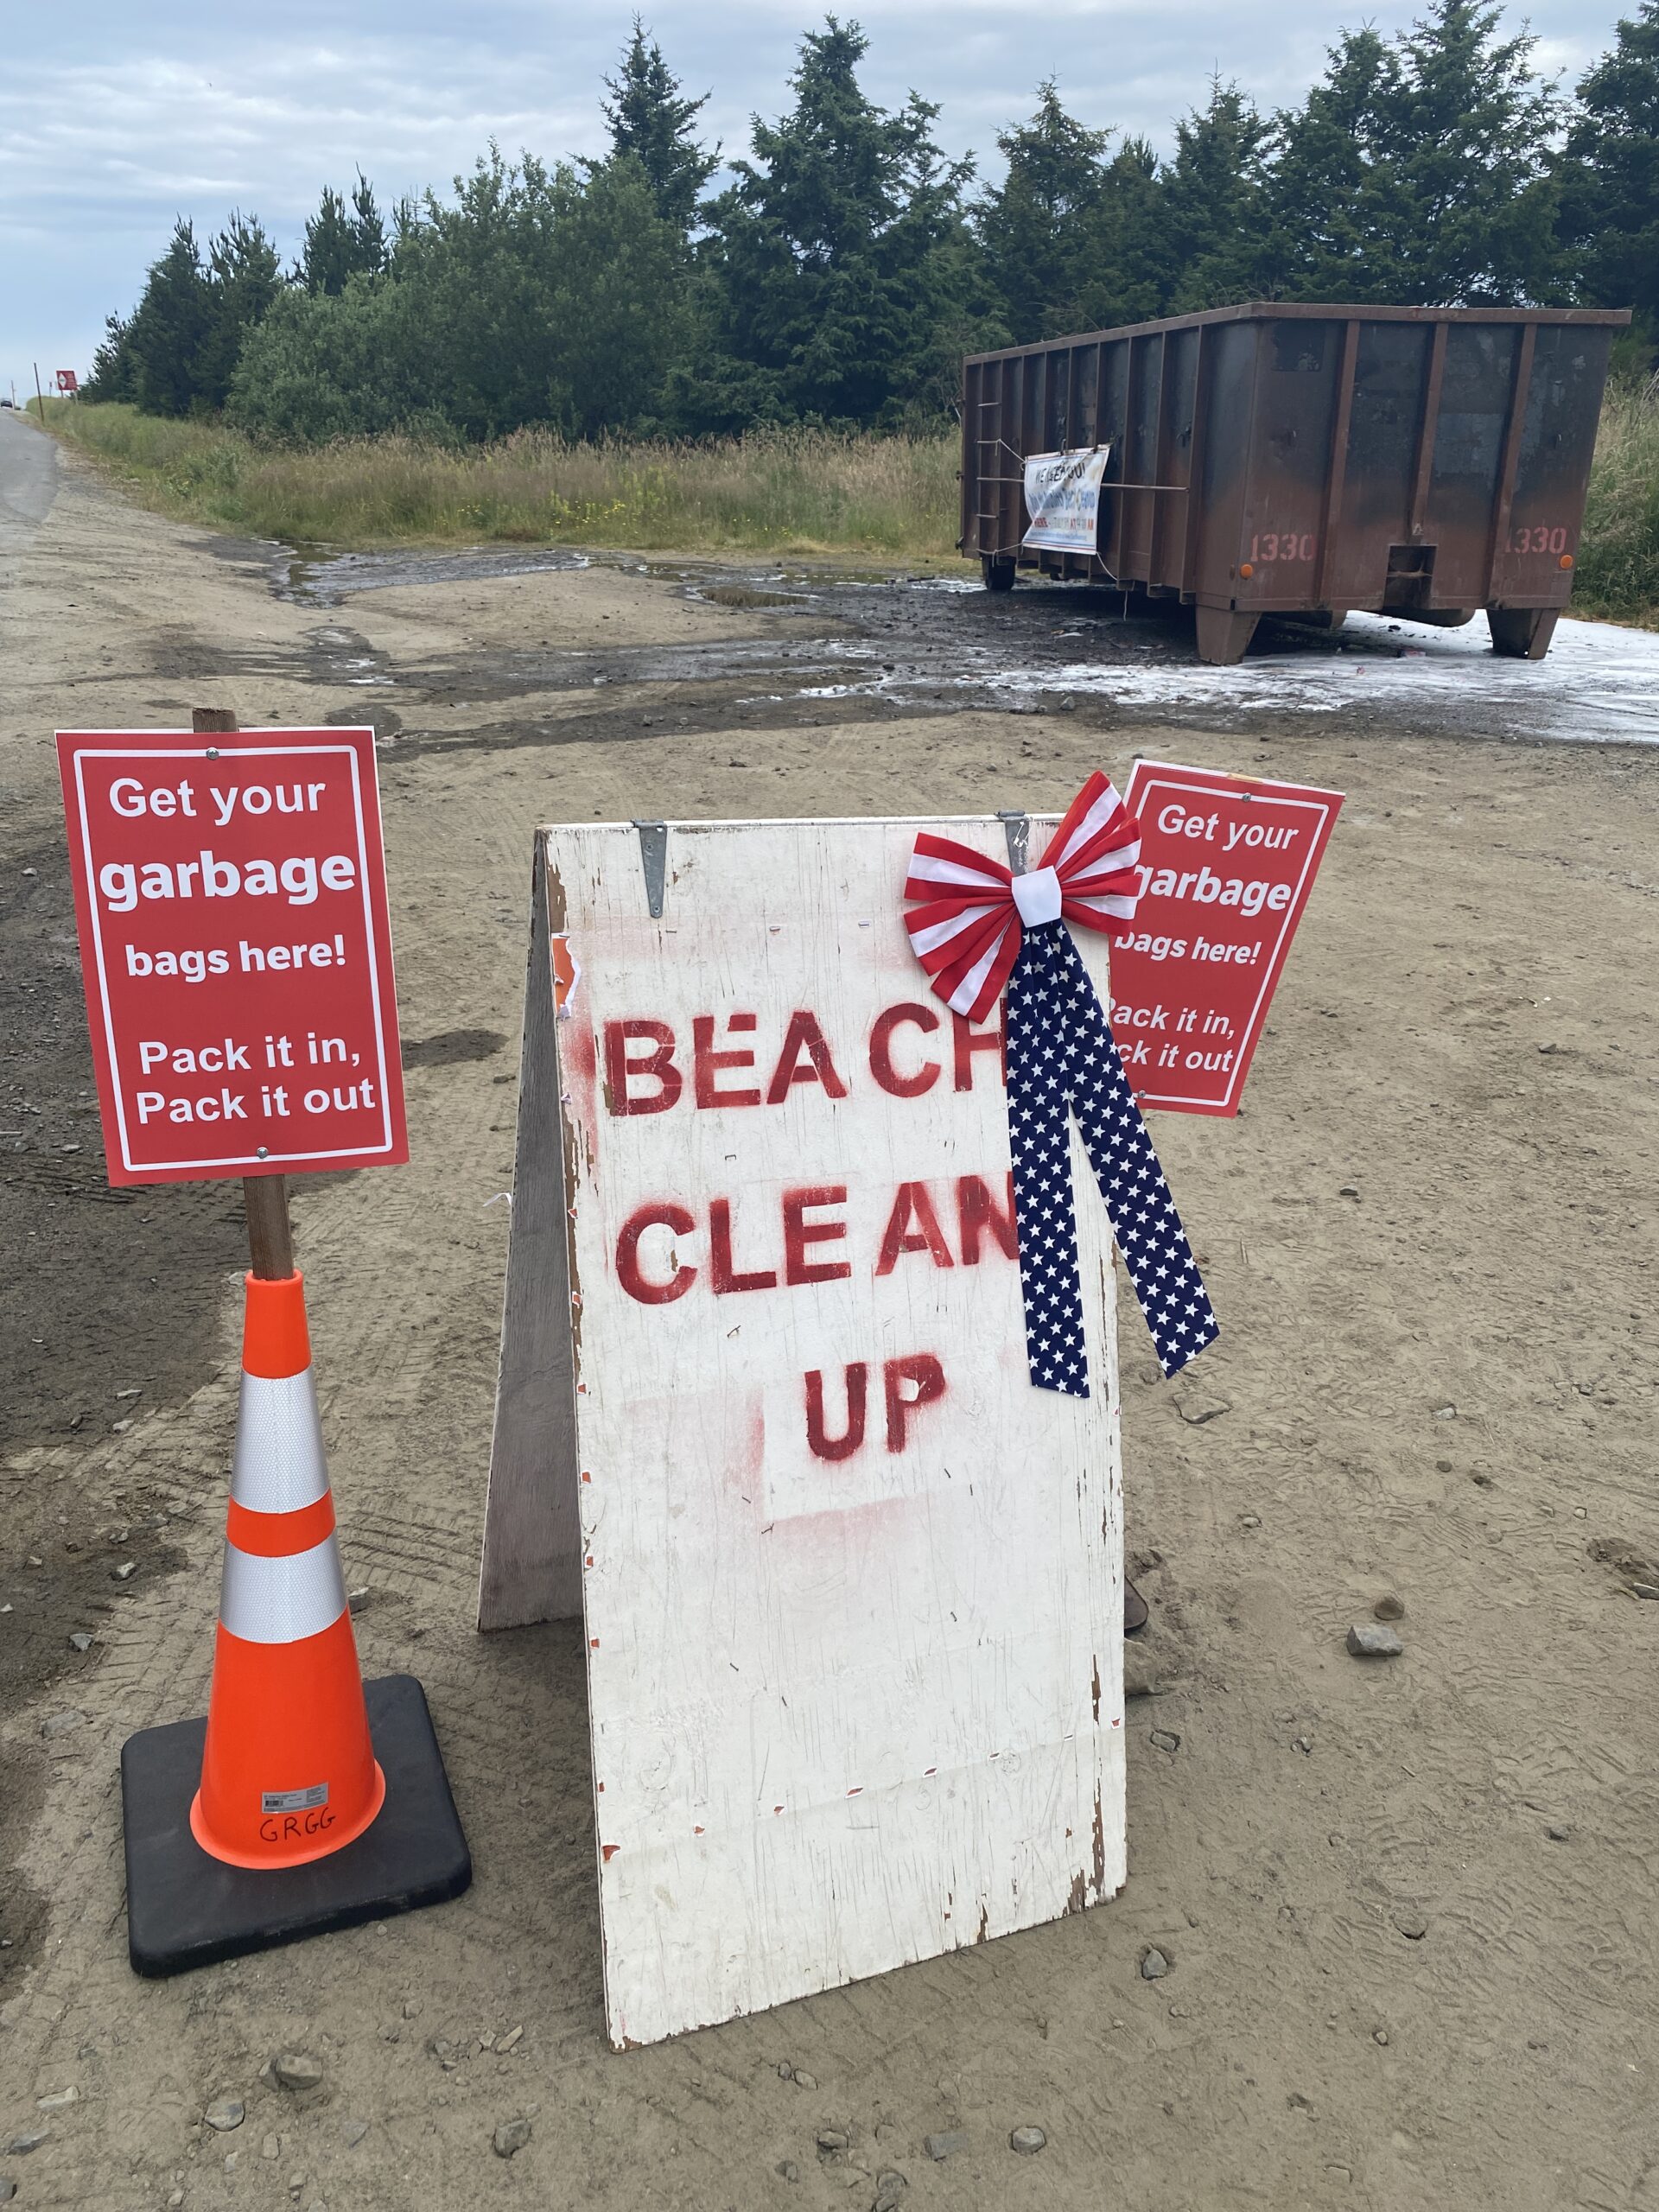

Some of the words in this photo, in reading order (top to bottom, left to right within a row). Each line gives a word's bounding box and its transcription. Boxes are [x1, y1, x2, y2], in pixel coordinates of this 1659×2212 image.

[1250, 533, 1318, 562] 1330
[1504, 526, 1567, 554] 1330
[109, 778, 197, 817] Get
[209, 783, 327, 826] your
[1158, 804, 1220, 841] Get
[1222, 822, 1300, 851] your
[99, 849, 356, 912] garbage
[124, 944, 230, 983] bags
[238, 934, 346, 972] here!
[1191, 936, 1262, 965] here!
[1109, 997, 1170, 1030] ack
[1176, 1007, 1198, 1033] it
[1202, 1010, 1235, 1040] in,
[138, 1038, 252, 1075] Pack
[264, 1035, 295, 1068] it
[307, 1032, 360, 1067] in,
[605, 997, 1007, 1116] BEACH
[1158, 1043, 1179, 1068] it
[1185, 1049, 1234, 1072] out
[136, 1088, 249, 1124] Pack
[261, 1085, 291, 1117] it
[303, 1077, 376, 1114] out
[615, 1171, 1020, 1305] CLEAN
[804, 1352, 947, 1464] UP
[259, 1807, 336, 1841] GRGG
